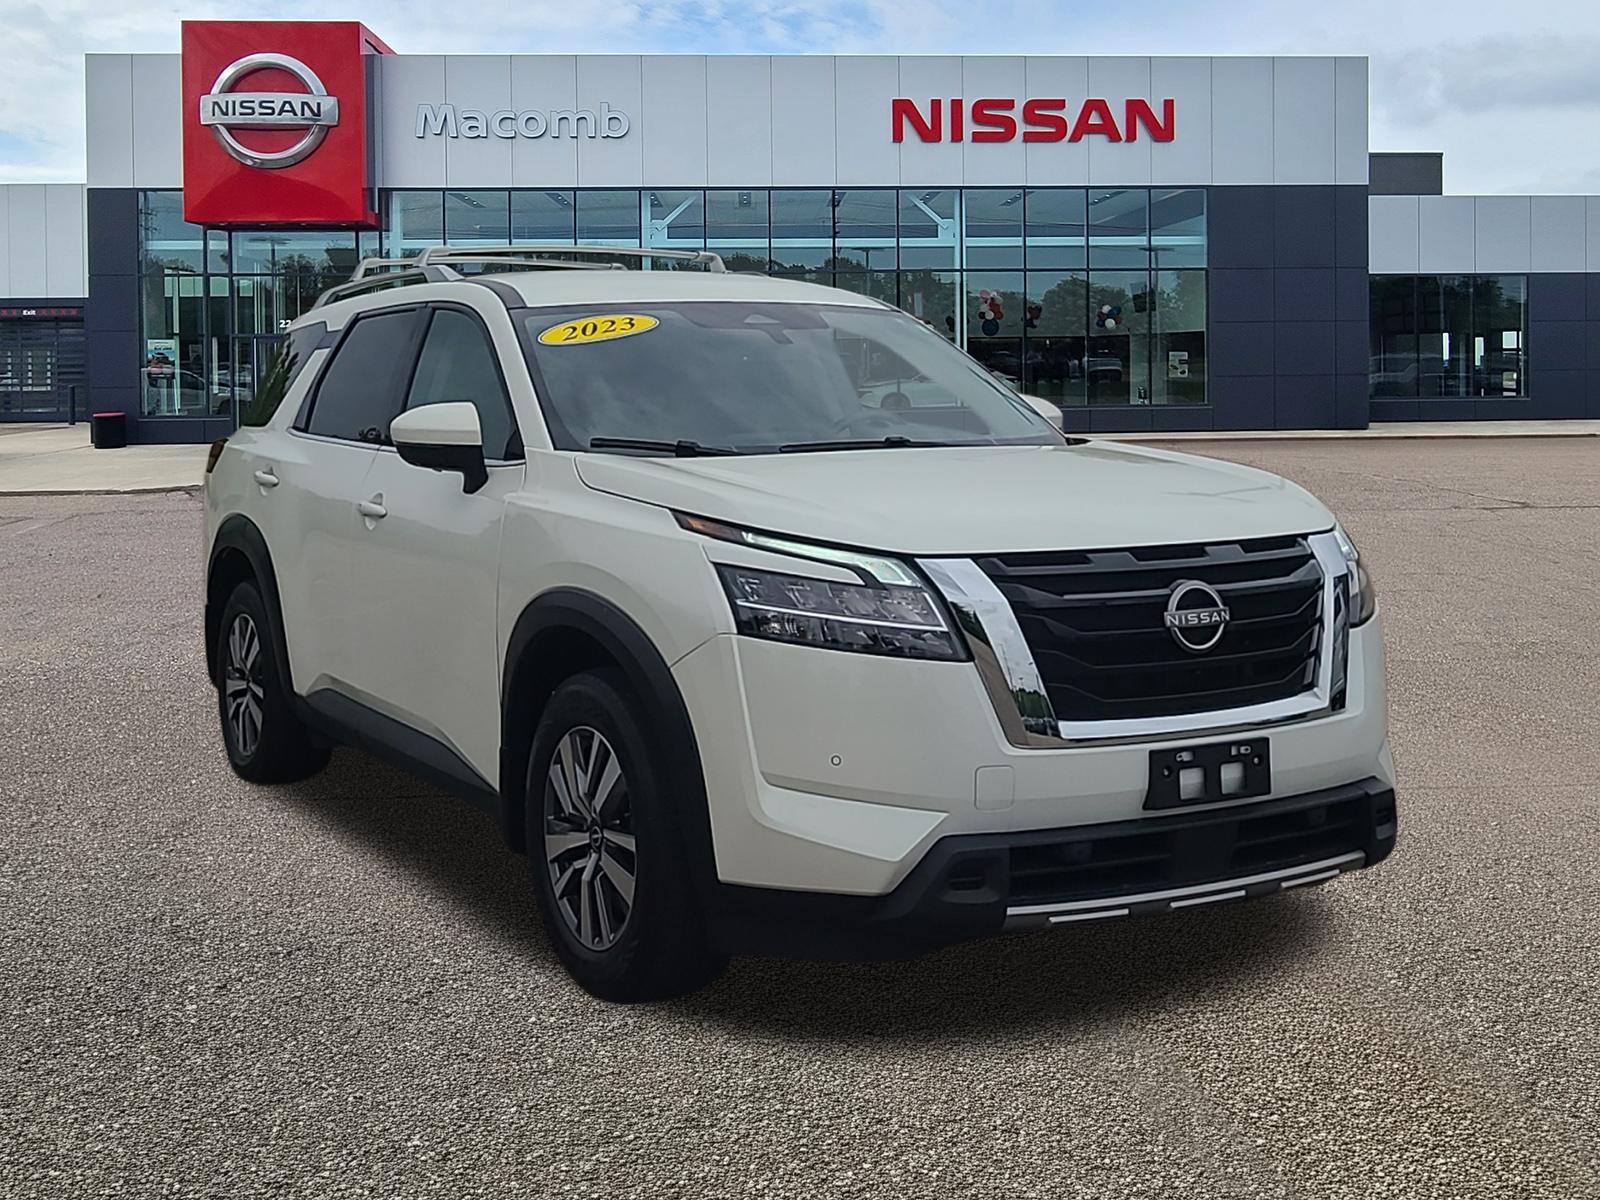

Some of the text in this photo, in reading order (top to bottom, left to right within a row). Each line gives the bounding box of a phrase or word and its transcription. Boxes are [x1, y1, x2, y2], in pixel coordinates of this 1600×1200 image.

[212, 100, 321, 117] NISSAN
[415, 102, 630, 139] Macomb
[892, 98, 1175, 143] NISSAN
[562, 316, 635, 341] 2023
[1166, 610, 1230, 627] NISSAN
